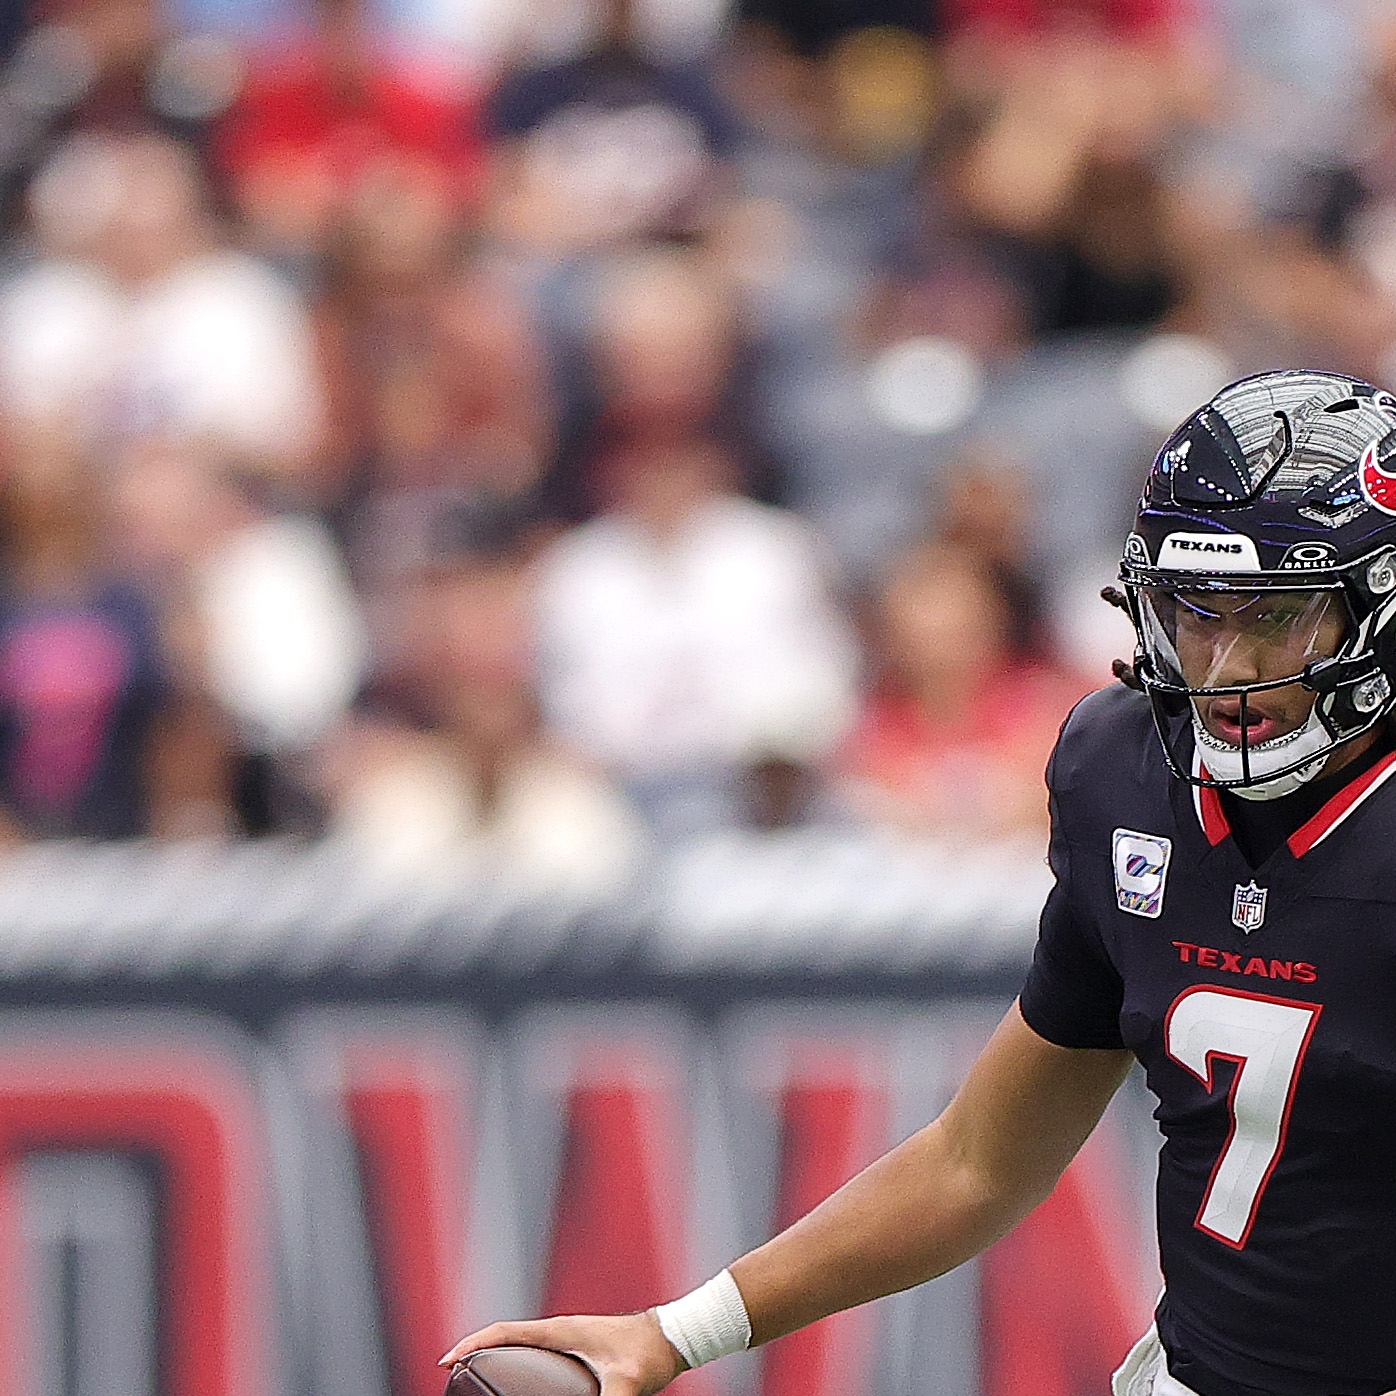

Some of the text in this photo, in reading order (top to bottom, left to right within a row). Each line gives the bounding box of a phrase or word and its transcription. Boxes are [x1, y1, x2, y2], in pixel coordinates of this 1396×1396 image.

[1170, 539, 1243, 554] TEXANS
[1284, 559, 1336, 569] OAKLEY
[1236, 902, 1261, 923] NFL
[1171, 940, 1318, 984] TEXANS
[1164, 983, 1324, 1250] 7
